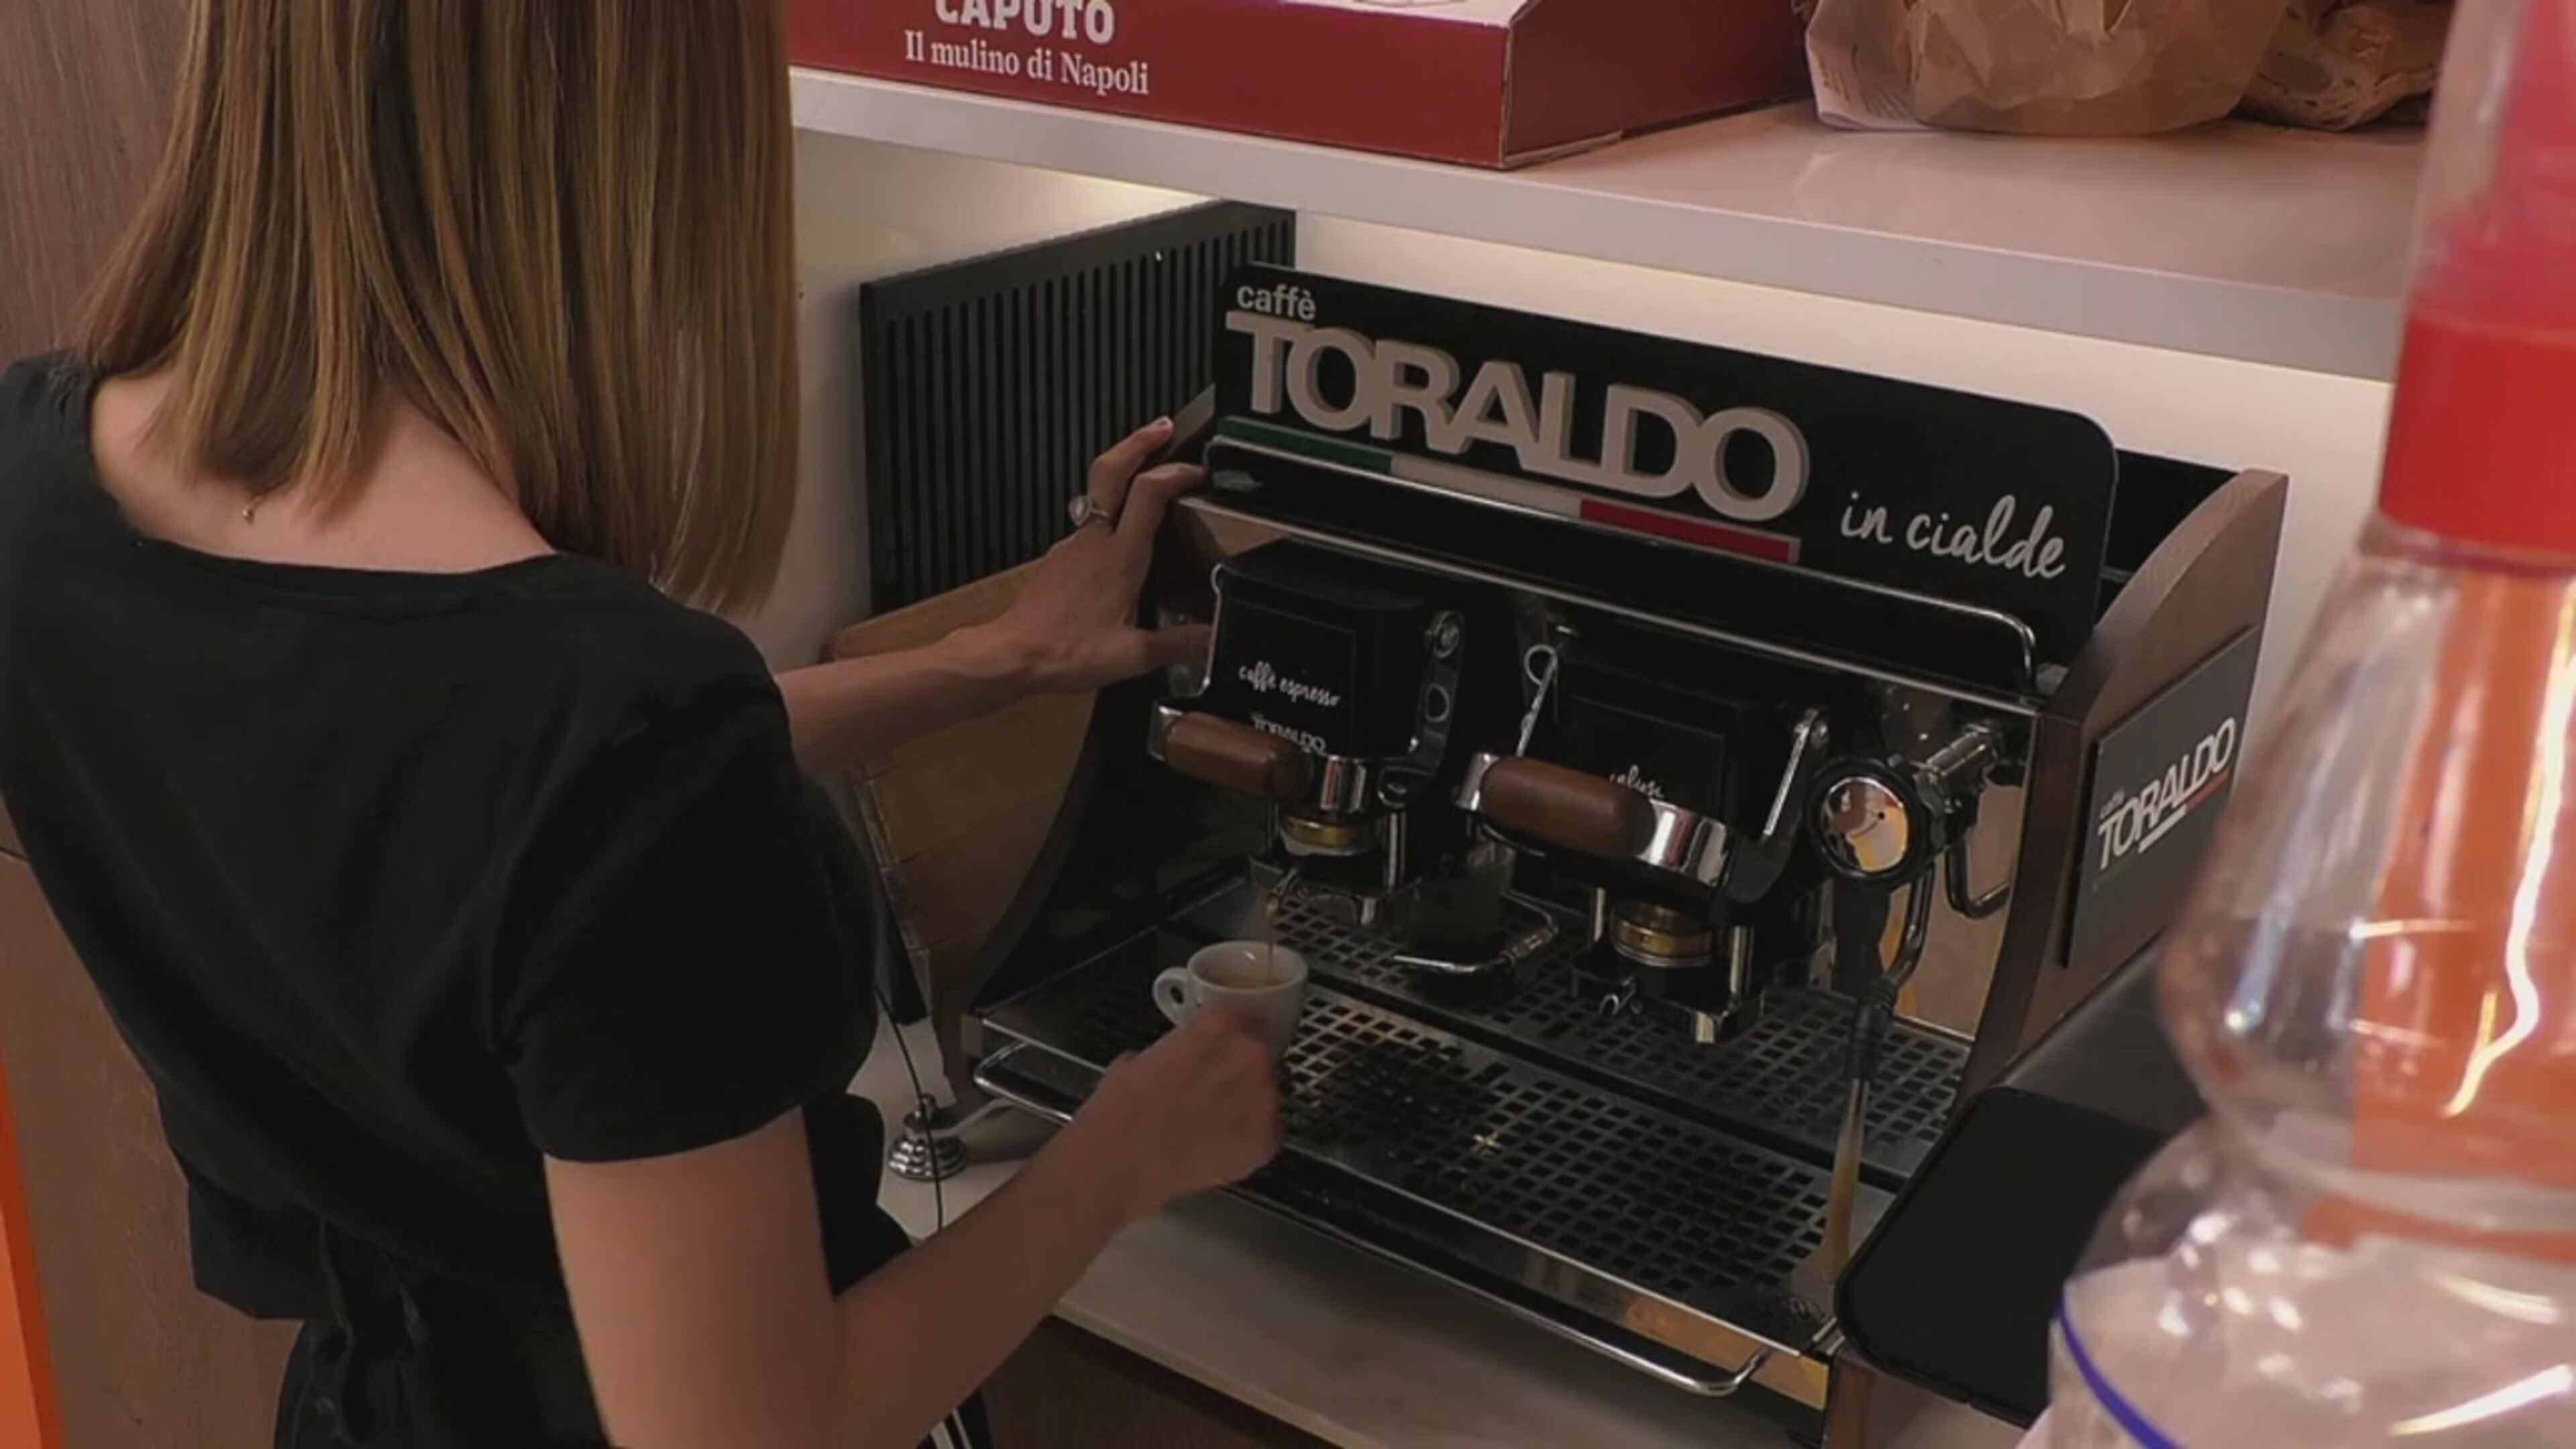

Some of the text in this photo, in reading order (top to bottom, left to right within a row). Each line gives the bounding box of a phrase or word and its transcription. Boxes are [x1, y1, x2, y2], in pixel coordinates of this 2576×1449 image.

[934, 0, 1115, 44] CAPUTO
[904, 30, 1149, 96] Il mulino di Napoli
[1236, 283, 1317, 321] caffè
[1226, 310, 1811, 522] TORALDO
[1841, 491, 2065, 579] in cialde
[2098, 716, 2236, 870] TORALDO
